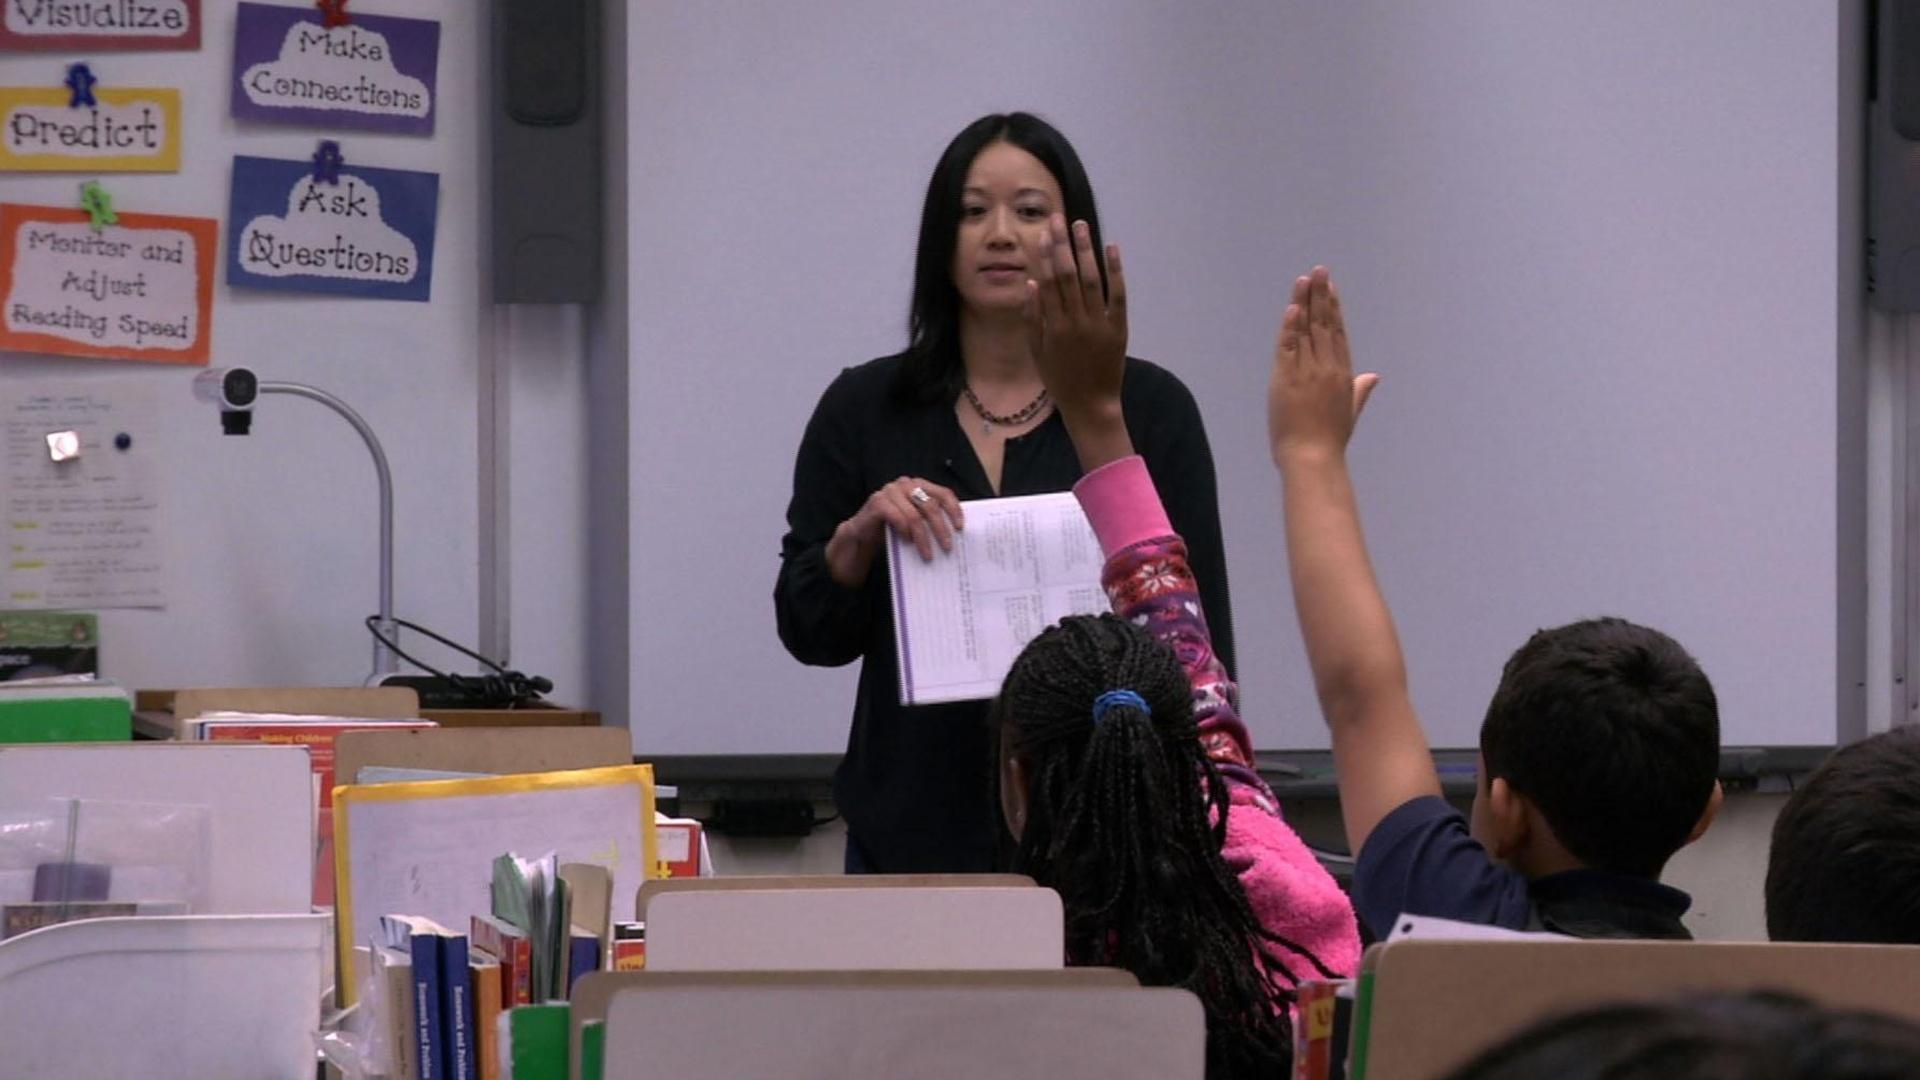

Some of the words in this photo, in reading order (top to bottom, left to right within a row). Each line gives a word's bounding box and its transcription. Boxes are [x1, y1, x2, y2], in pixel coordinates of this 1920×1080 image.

[16, 0, 184, 29] Visualize
[299, 30, 383, 61] Make
[250, 70, 422, 111] Connections
[10, 109, 158, 149] Predict
[299, 182, 369, 218] Ask
[29, 229, 129, 260] Monitor
[142, 240, 184, 264] and
[248, 230, 411, 277] Questions
[61, 270, 147, 301] Adjust
[12, 303, 108, 335] Reading
[118, 315, 189, 345] Speed
